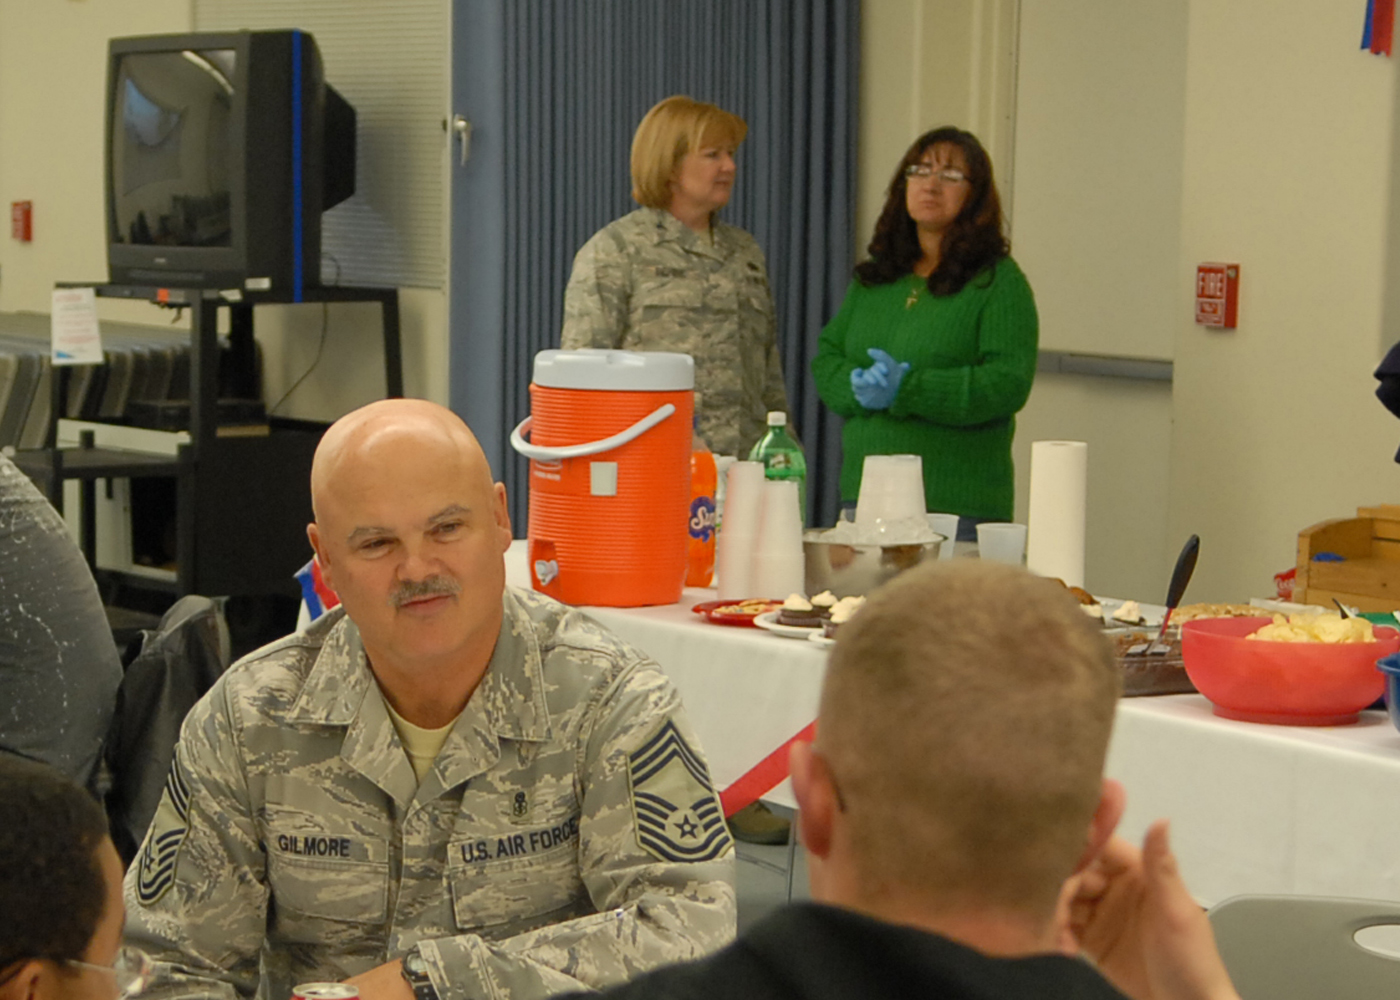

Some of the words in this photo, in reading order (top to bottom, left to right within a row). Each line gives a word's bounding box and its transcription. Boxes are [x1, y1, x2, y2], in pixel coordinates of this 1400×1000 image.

[1198, 272, 1222, 296] FIRE
[278, 834, 351, 858] GILMORE
[461, 843, 493, 864] U.S.
[497, 834, 526, 859] AIR
[529, 816, 579, 853] FORCE
